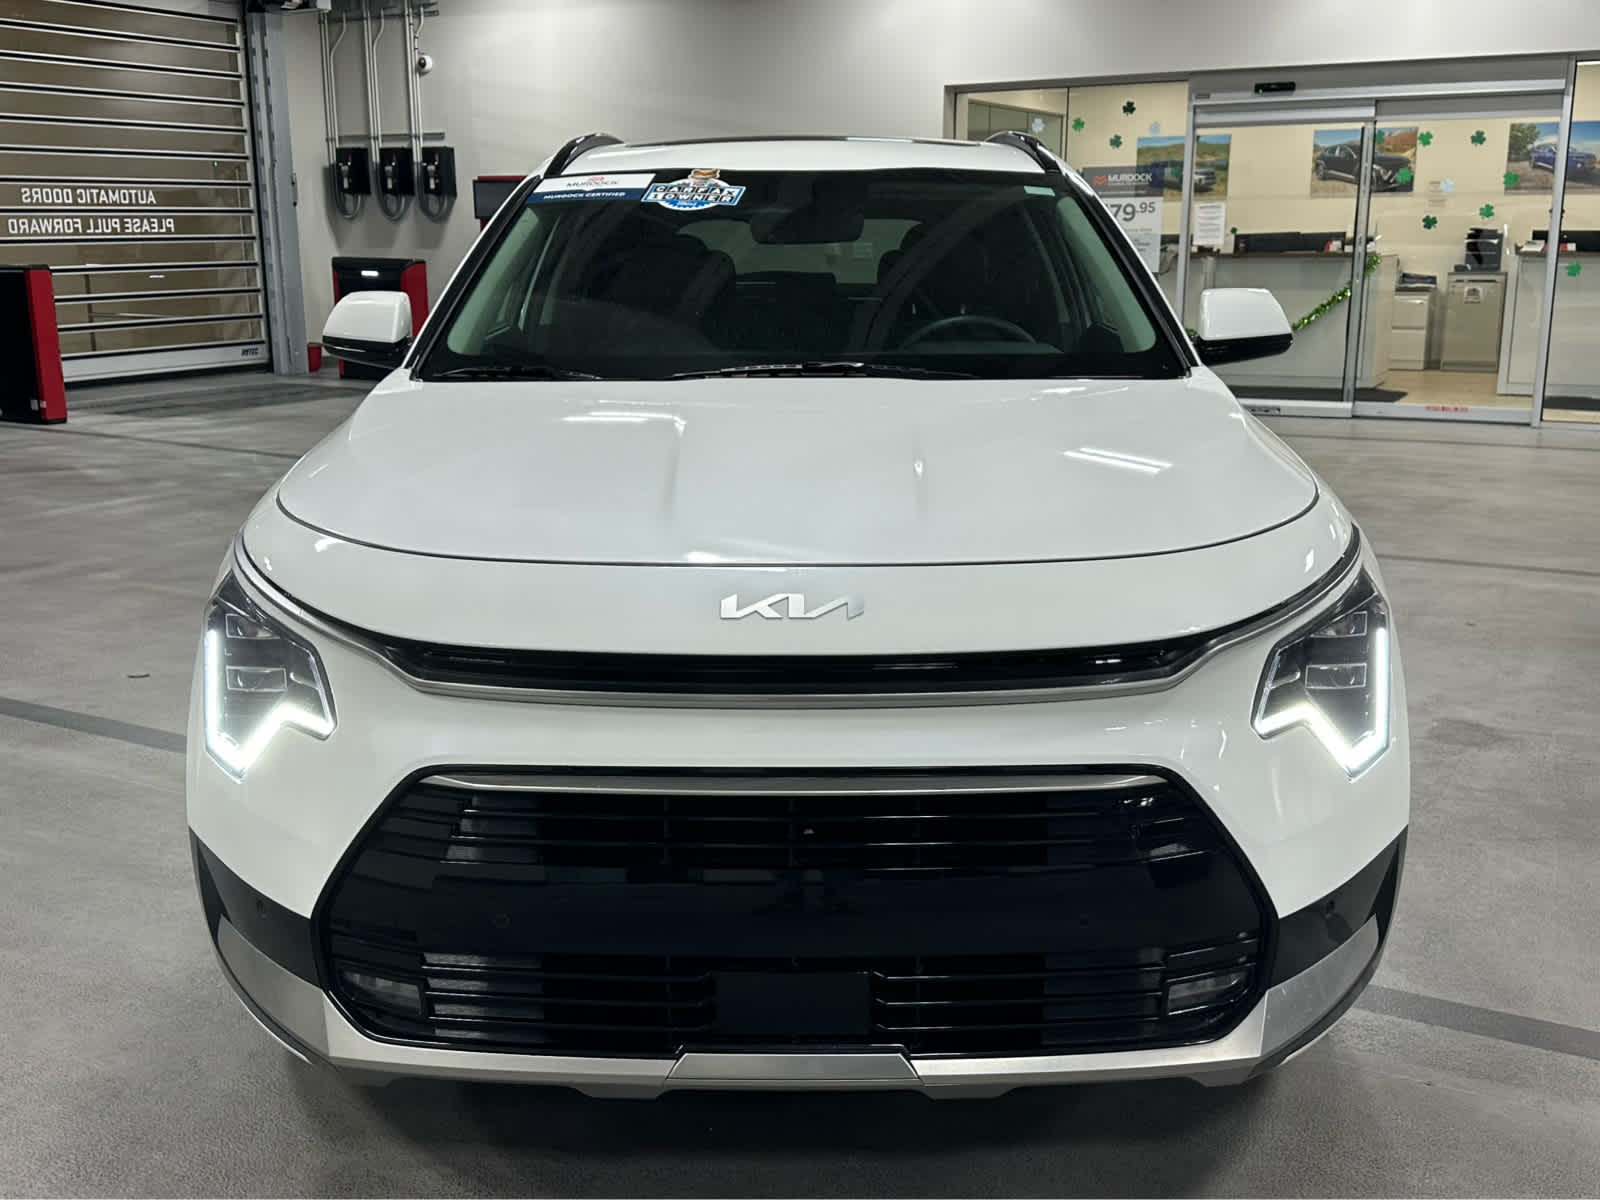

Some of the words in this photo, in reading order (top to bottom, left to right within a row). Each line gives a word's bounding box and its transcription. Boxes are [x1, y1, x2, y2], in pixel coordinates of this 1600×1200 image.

[1108, 173, 1153, 182] MURDOCK
[656, 185, 736, 196] CARFAX
[664, 193, 734, 203] OWNER
[1106, 202, 1156, 222] 79.95
[720, 593, 865, 621] KIA
